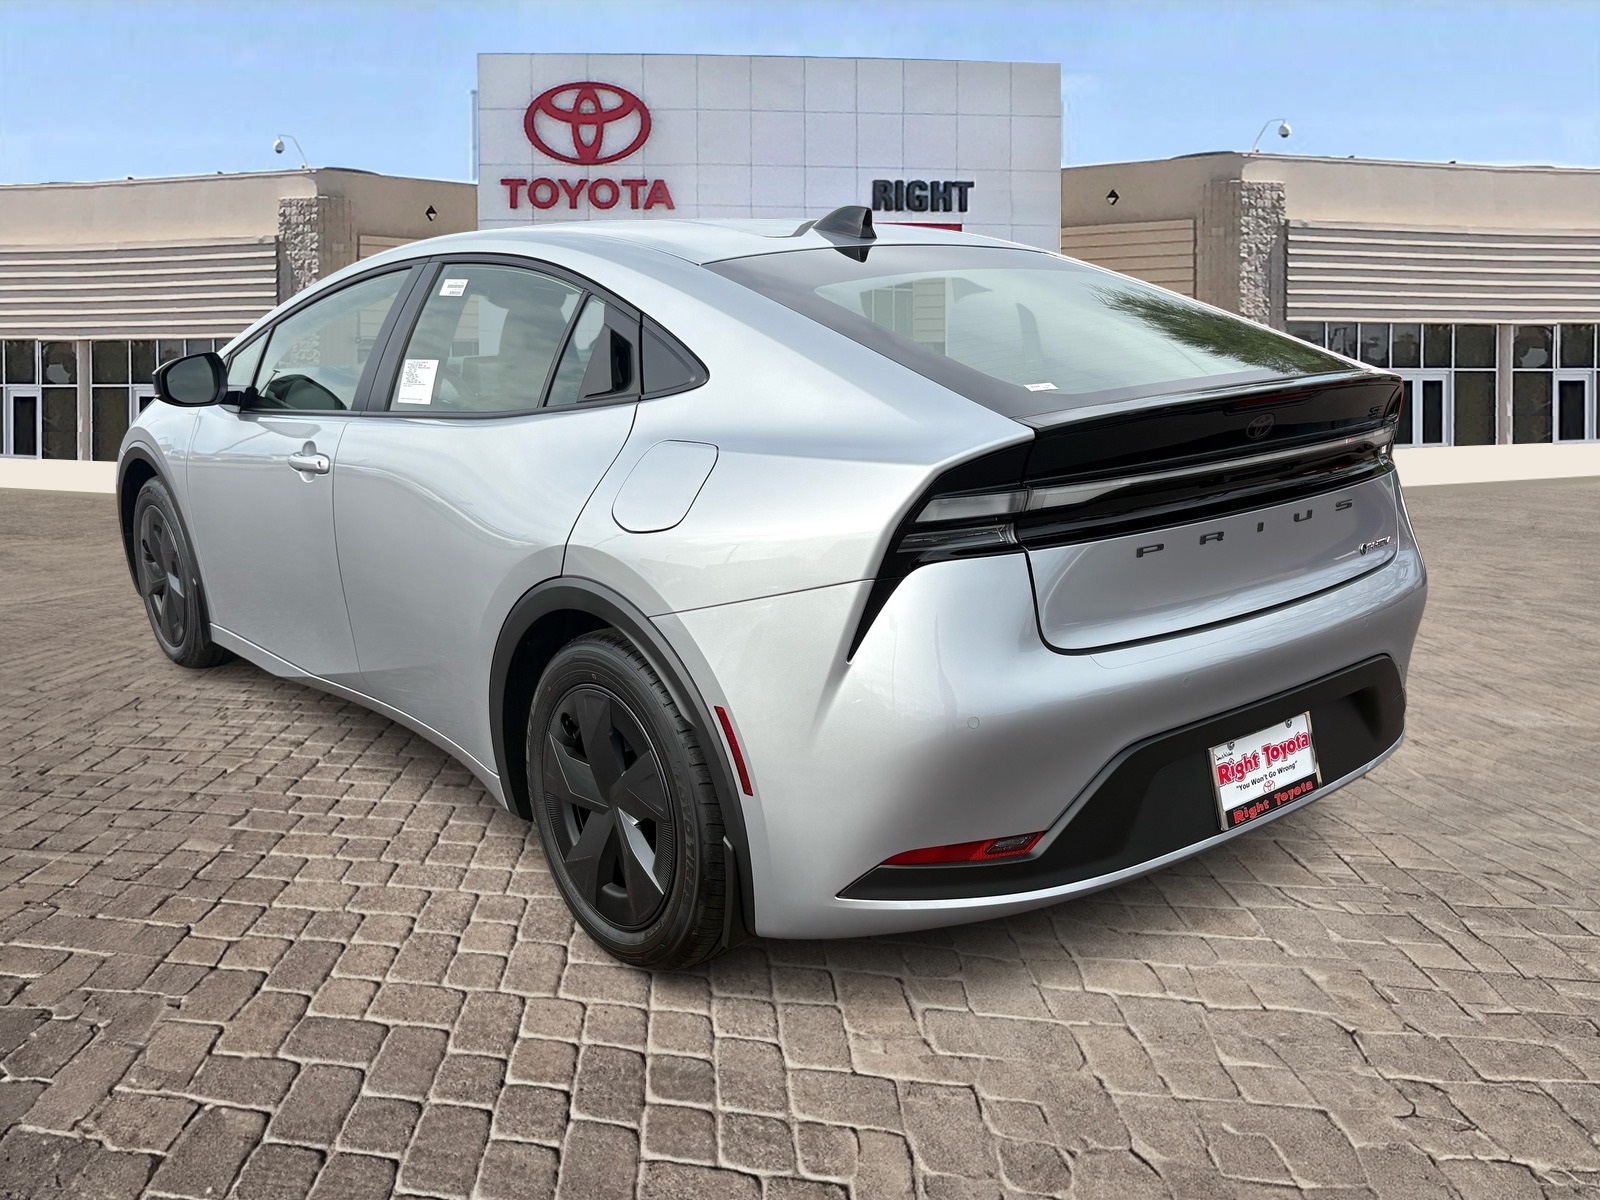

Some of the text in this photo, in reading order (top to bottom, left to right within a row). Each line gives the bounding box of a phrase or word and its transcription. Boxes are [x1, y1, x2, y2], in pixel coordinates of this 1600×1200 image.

[500, 178, 675, 209] TOYOTA
[872, 179, 974, 212] RIGHT
[1136, 499, 1353, 558] PRIUS
[1217, 732, 1310, 787] Right Toyota
[1251, 774, 1268, 785] Won't
[1233, 780, 1313, 823] Right Toyota
